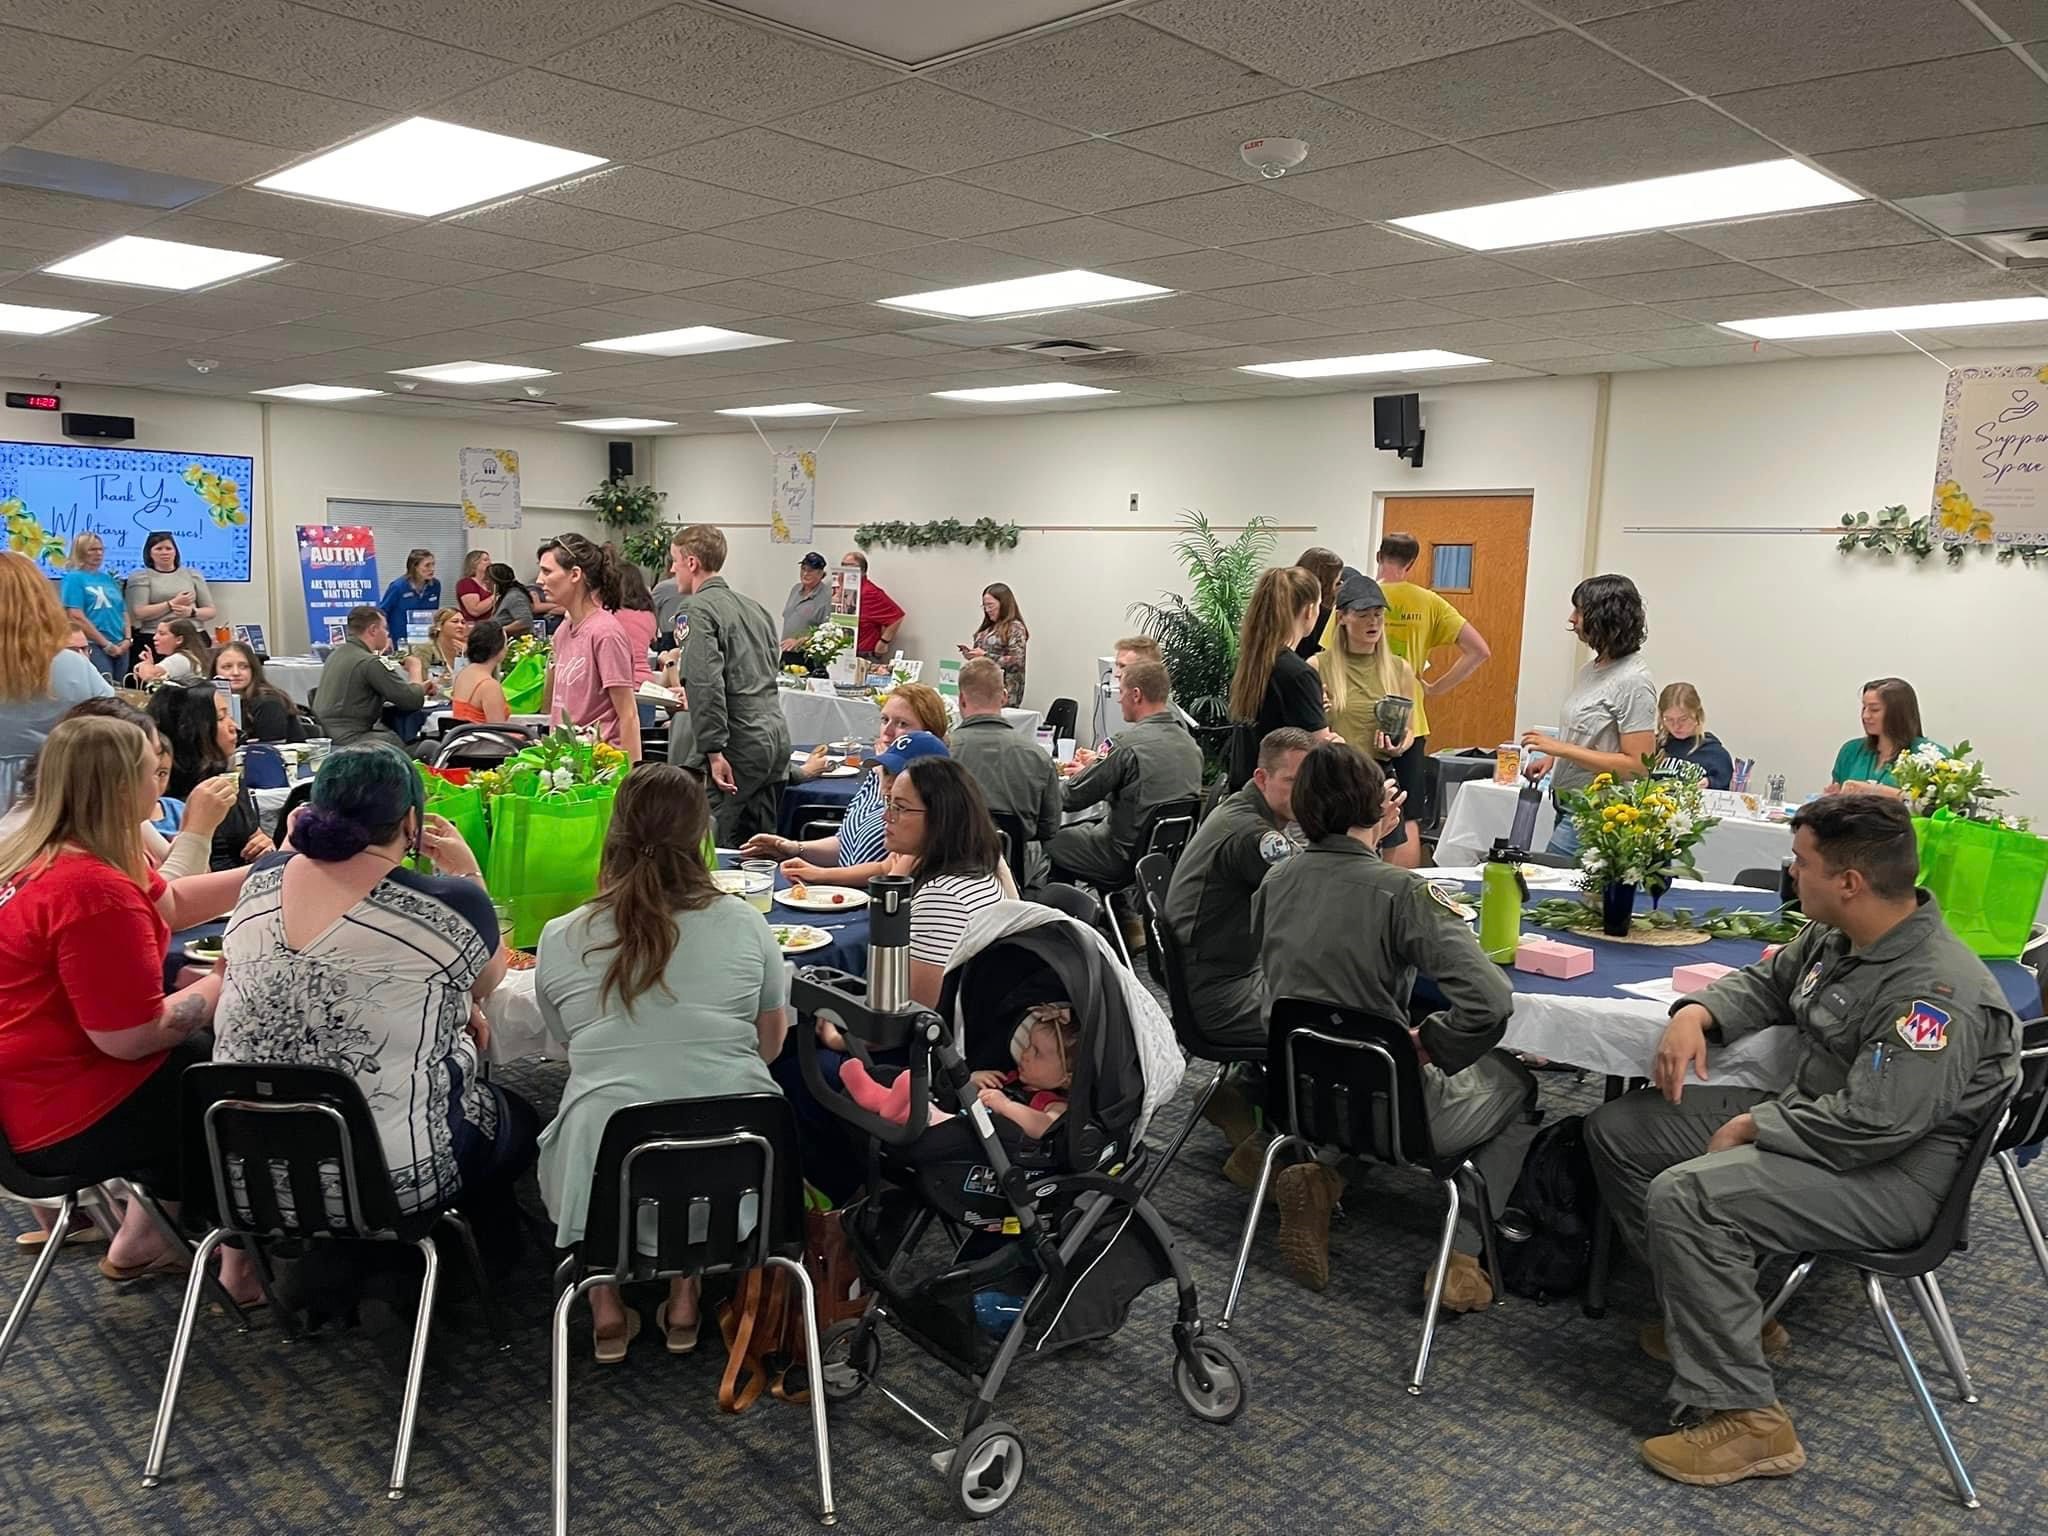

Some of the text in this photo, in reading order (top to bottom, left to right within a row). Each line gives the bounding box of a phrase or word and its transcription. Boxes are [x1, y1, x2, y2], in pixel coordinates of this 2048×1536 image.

[1975, 422, 2048, 459] Suppor
[1982, 450, 2044, 485] Space
[80, 474, 179, 513] Thank You
[52, 501, 203, 547] Military Suses!
[311, 547, 365, 563] AUTRY
[311, 580, 372, 589] ARE YOU WHERE YOU
[323, 589, 363, 599] WANT TO BE?
[1401, 613, 1422, 621] HAITI
